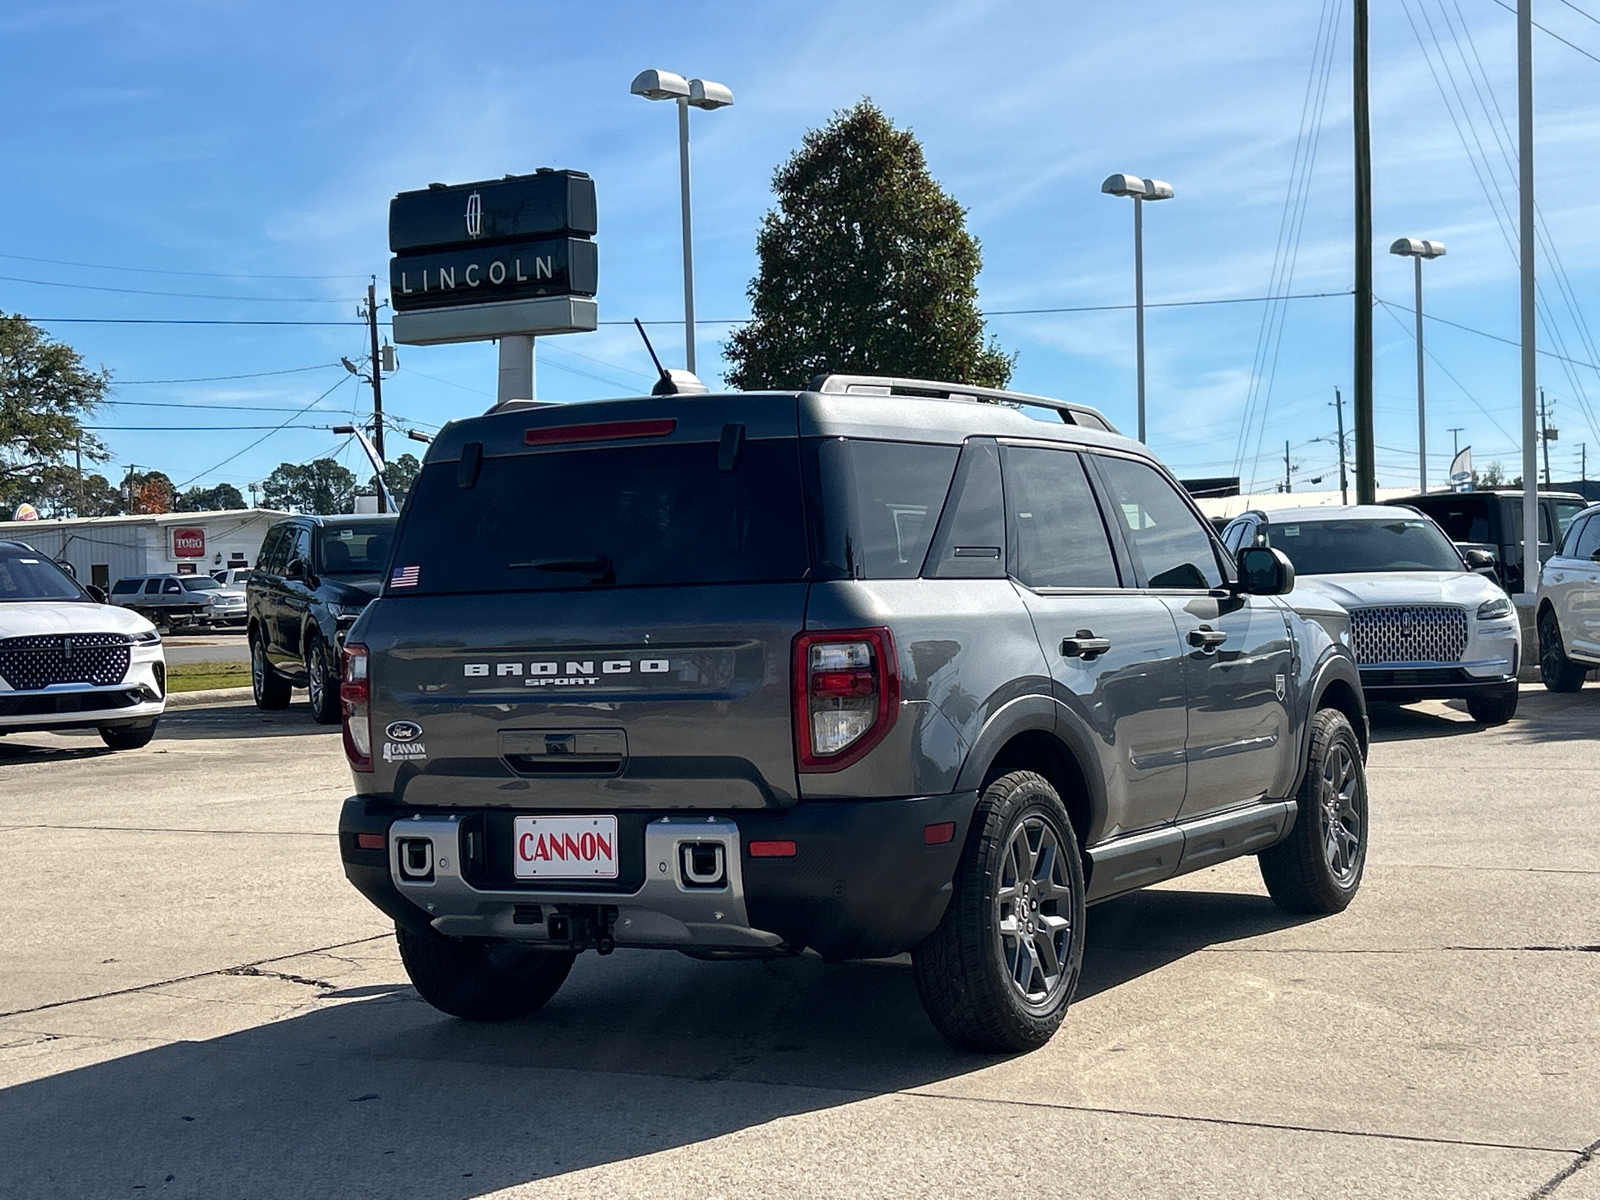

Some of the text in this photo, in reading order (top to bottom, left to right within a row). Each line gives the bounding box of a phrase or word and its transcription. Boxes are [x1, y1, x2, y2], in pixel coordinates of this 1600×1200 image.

[402, 255, 552, 294] LINCOLN
[176, 538, 202, 549] TORO
[464, 659, 670, 677] BRONCO
[524, 677, 600, 687] SPORT
[392, 724, 413, 737] Ford
[391, 743, 426, 754] CANNON
[519, 832, 612, 862] CANNON
